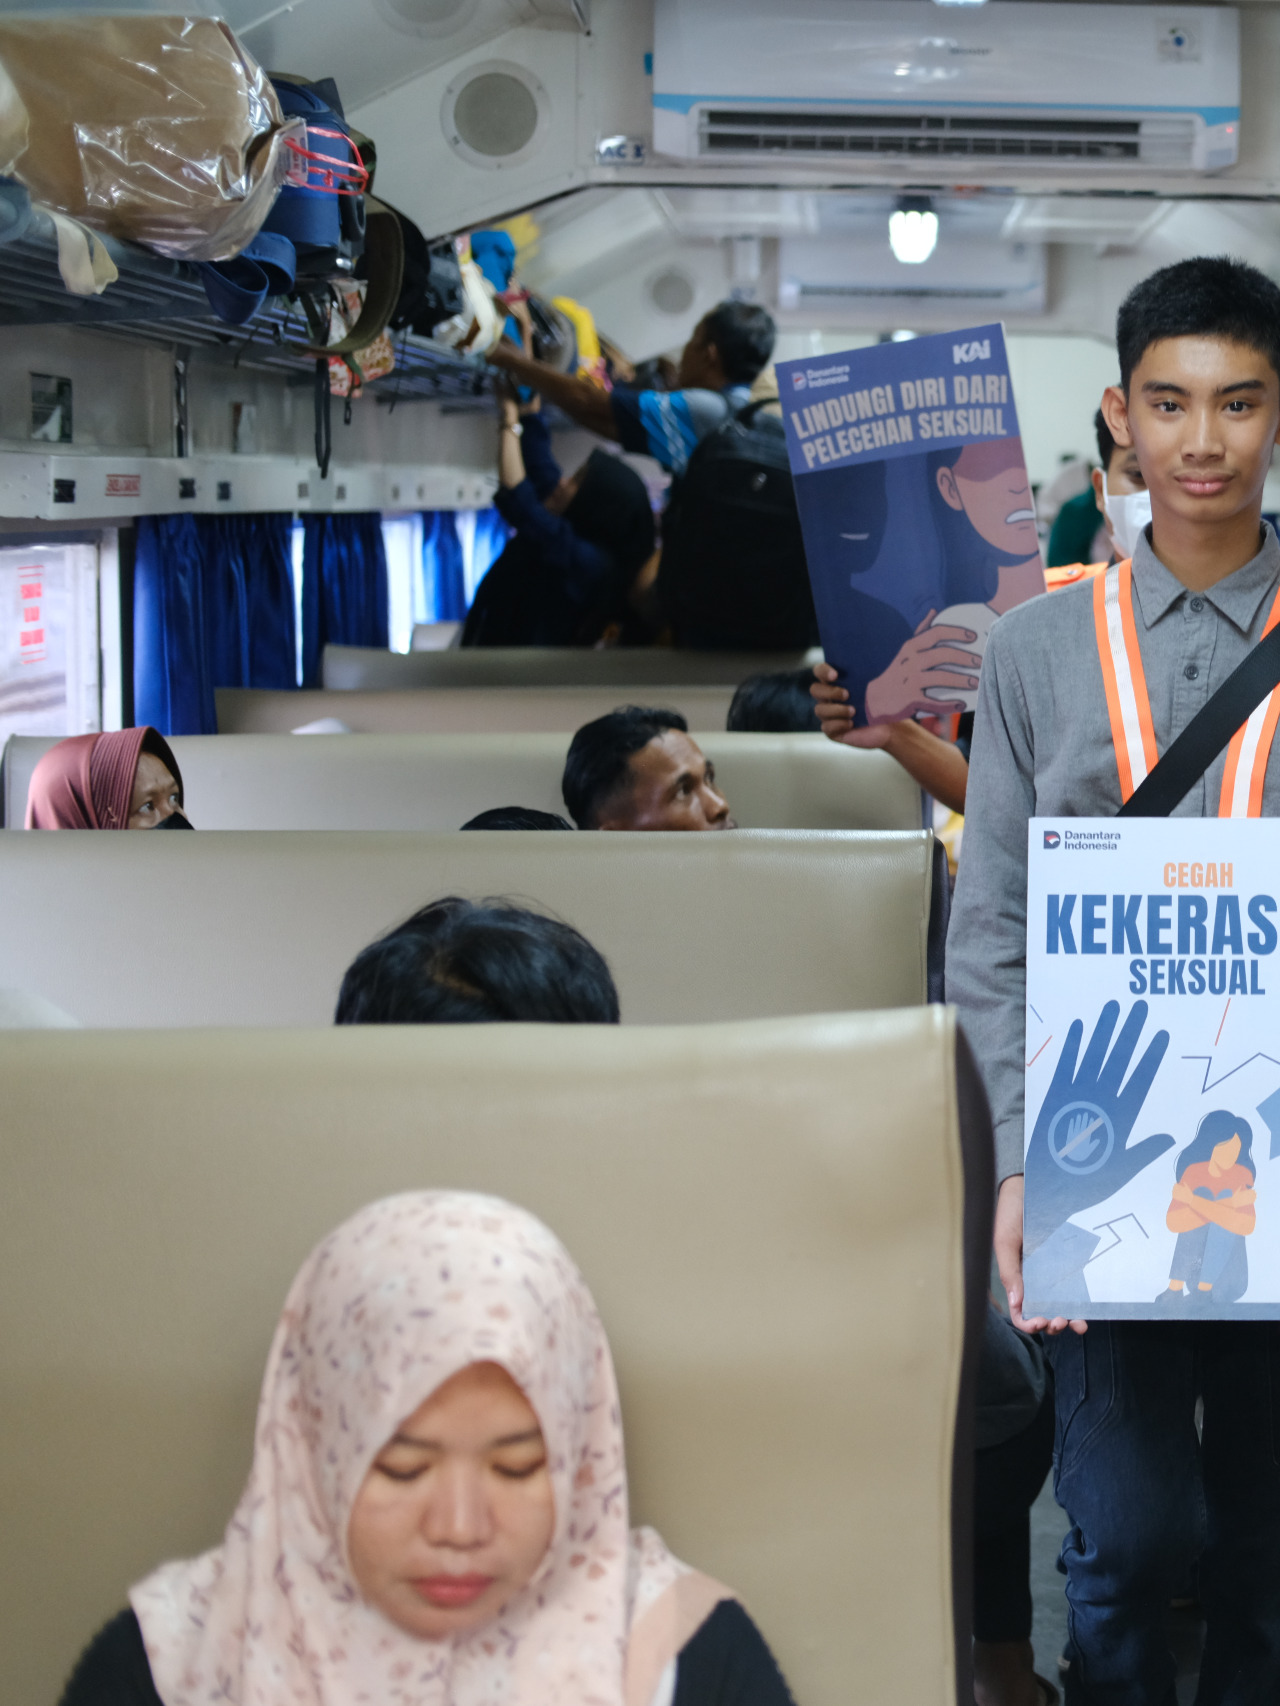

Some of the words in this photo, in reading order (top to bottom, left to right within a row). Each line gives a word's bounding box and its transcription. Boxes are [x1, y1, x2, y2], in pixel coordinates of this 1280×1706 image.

[952, 339, 991, 364] KAI
[790, 384, 896, 440] LINDUNGI
[900, 377, 947, 411] DIRI
[953, 374, 1007, 405] DARI
[801, 415, 914, 469] PELECEHAN
[918, 408, 1007, 439] SEKSUAL
[1064, 830, 1121, 840] Danantara
[1064, 841, 1118, 850] Indonesia
[1163, 862, 1233, 888] CEGAH
[1129, 959, 1266, 996] SEKSUAL
